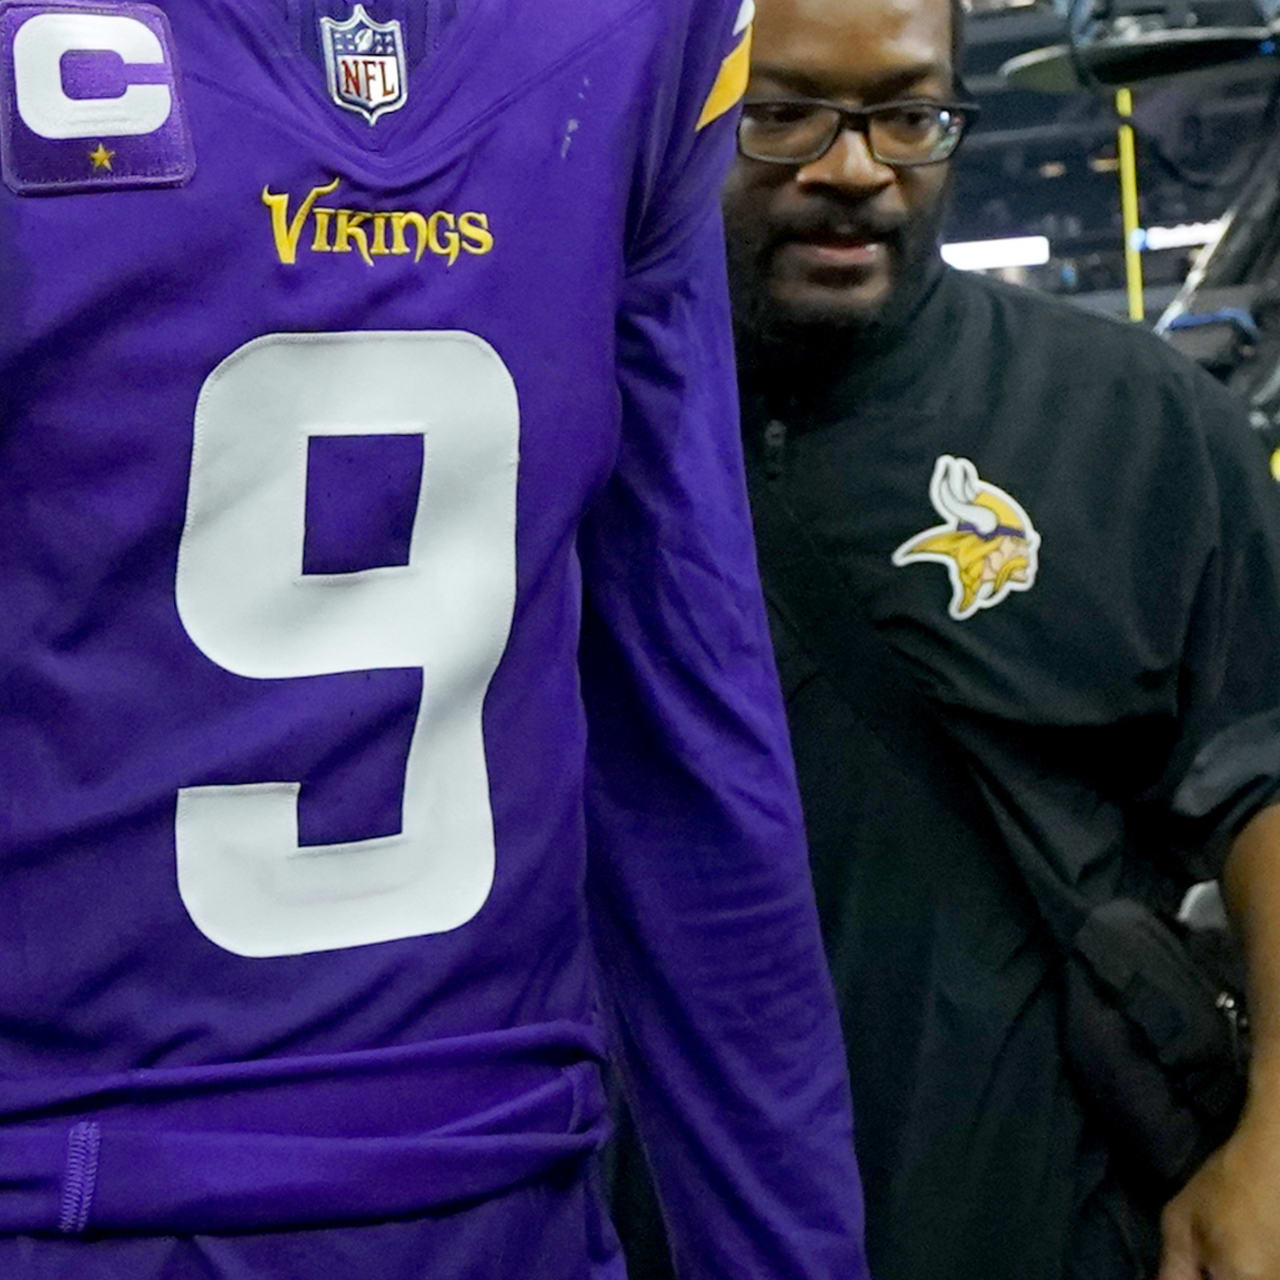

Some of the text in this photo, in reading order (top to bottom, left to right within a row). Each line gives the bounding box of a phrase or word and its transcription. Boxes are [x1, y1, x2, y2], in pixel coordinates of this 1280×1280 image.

[13, 12, 172, 140] C
[340, 59, 396, 101] NFL
[261, 176, 495, 268] VIKINGS
[175, 329, 520, 958] 9
